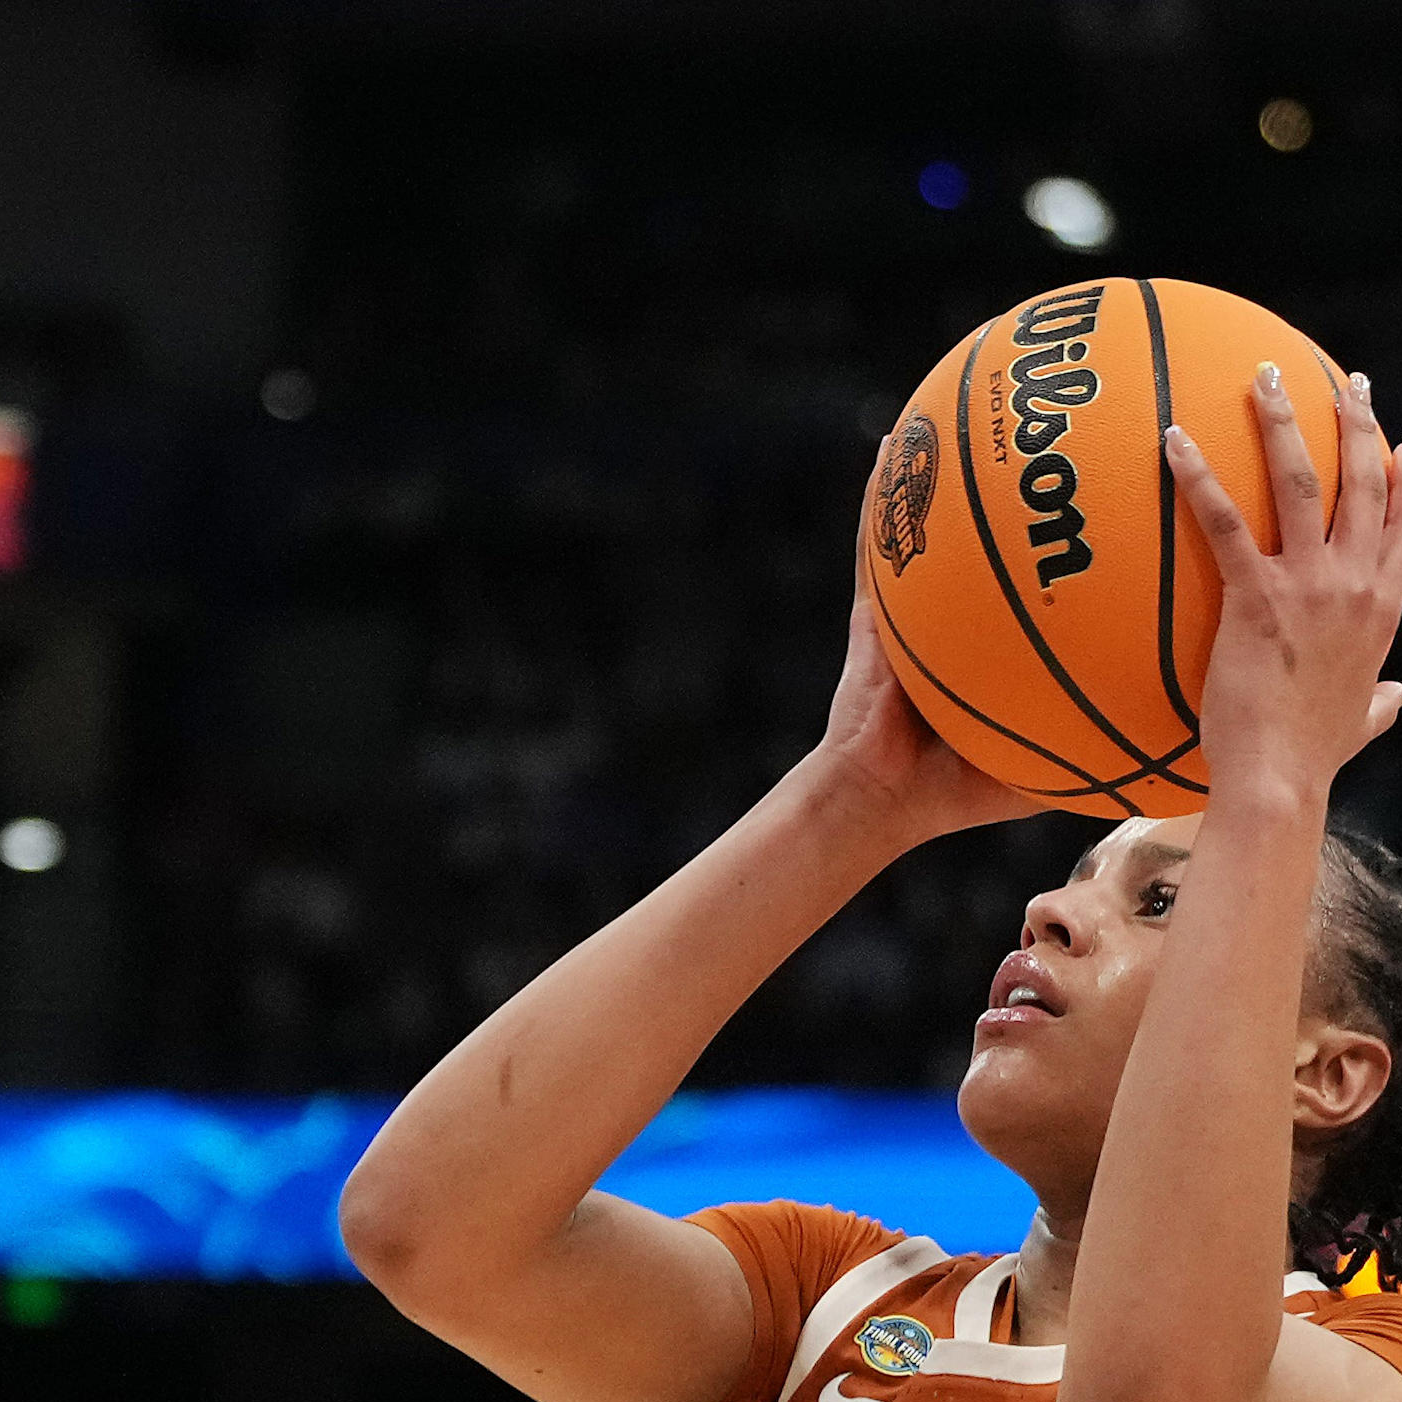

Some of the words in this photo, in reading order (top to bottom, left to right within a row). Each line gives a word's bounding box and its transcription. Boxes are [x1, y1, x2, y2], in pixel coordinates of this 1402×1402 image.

[988, 370, 1005, 415] EVO
[992, 416, 1008, 465] NXT
[1007, 285, 1106, 590] Wilson
[864, 1325, 899, 1349] FINAL
